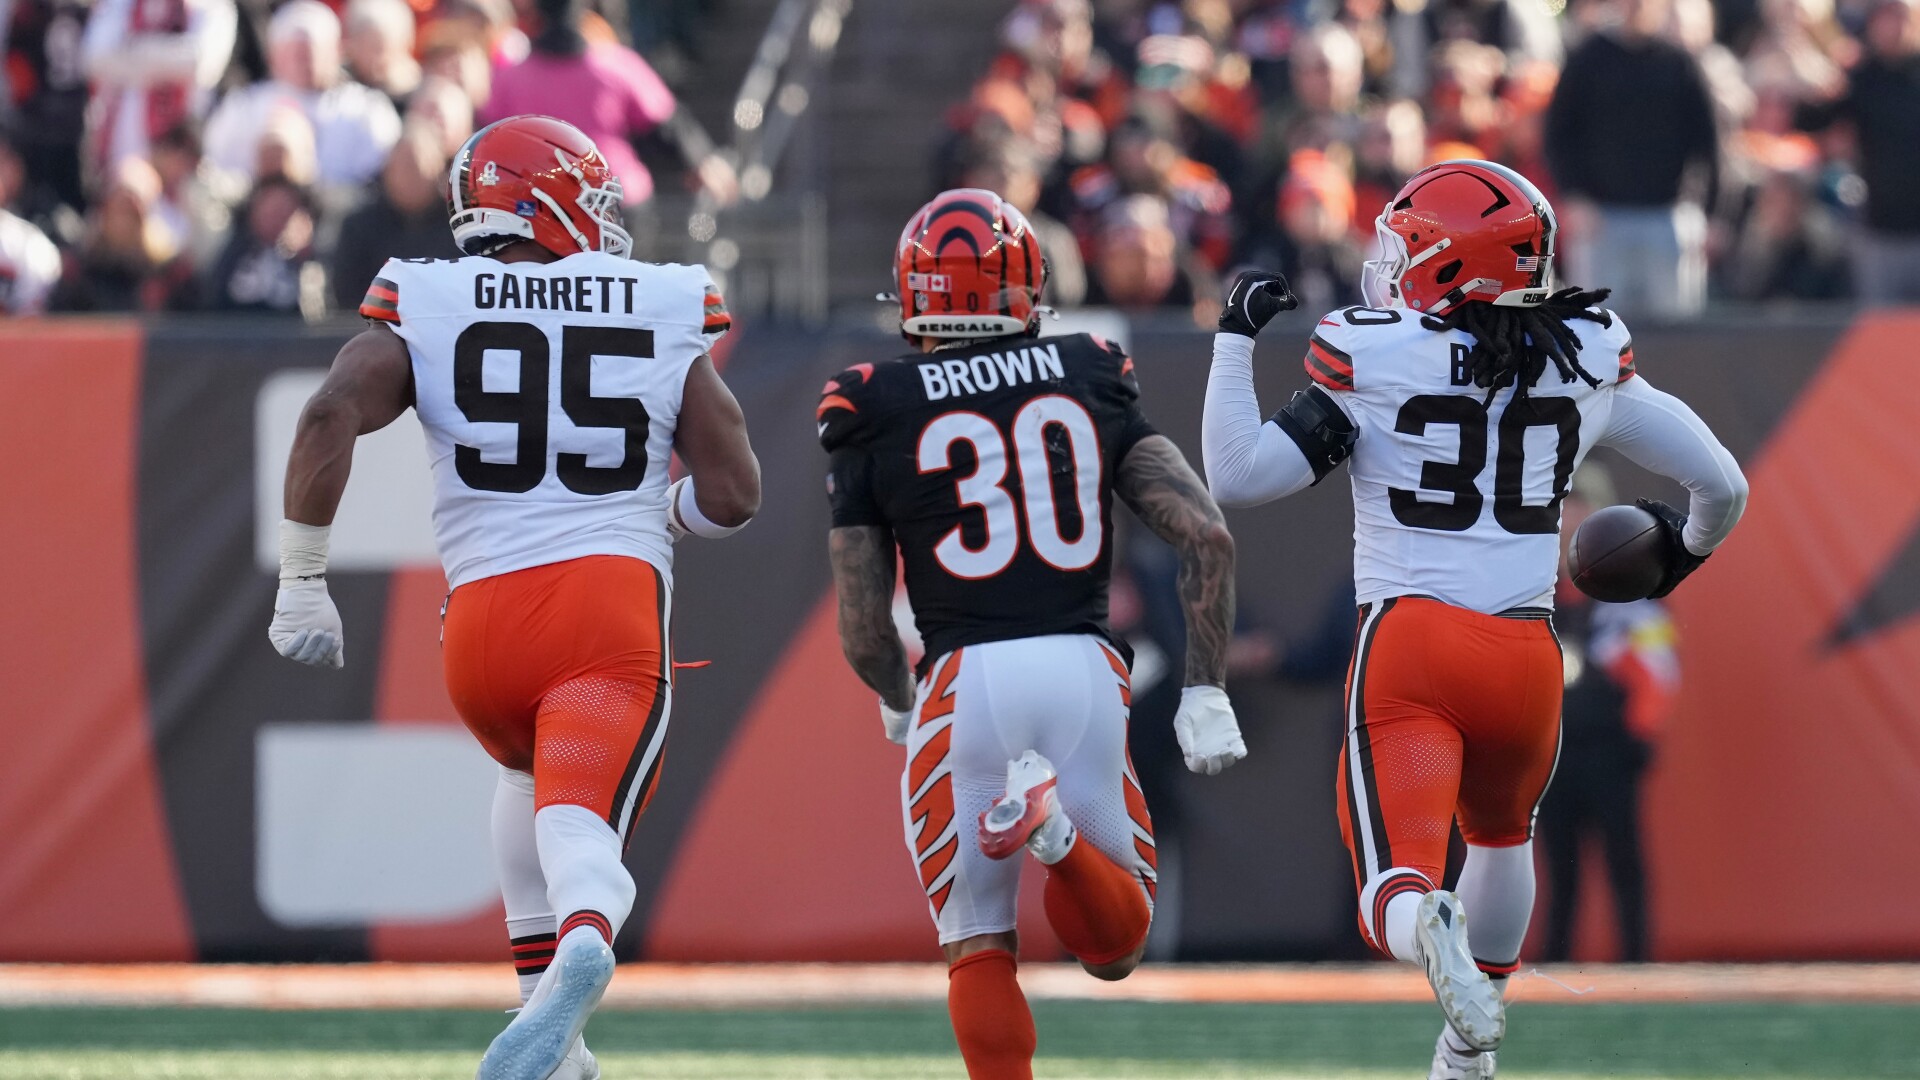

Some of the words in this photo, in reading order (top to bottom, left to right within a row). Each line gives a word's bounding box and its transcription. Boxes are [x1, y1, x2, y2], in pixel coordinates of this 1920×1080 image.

[474, 272, 638, 314] GARRETT
[917, 322, 1005, 333] BENGALS
[453, 321, 656, 495] 95
[917, 343, 1065, 401] BROWN
[916, 393, 1102, 580] 30
[1387, 395, 1582, 535] 30
